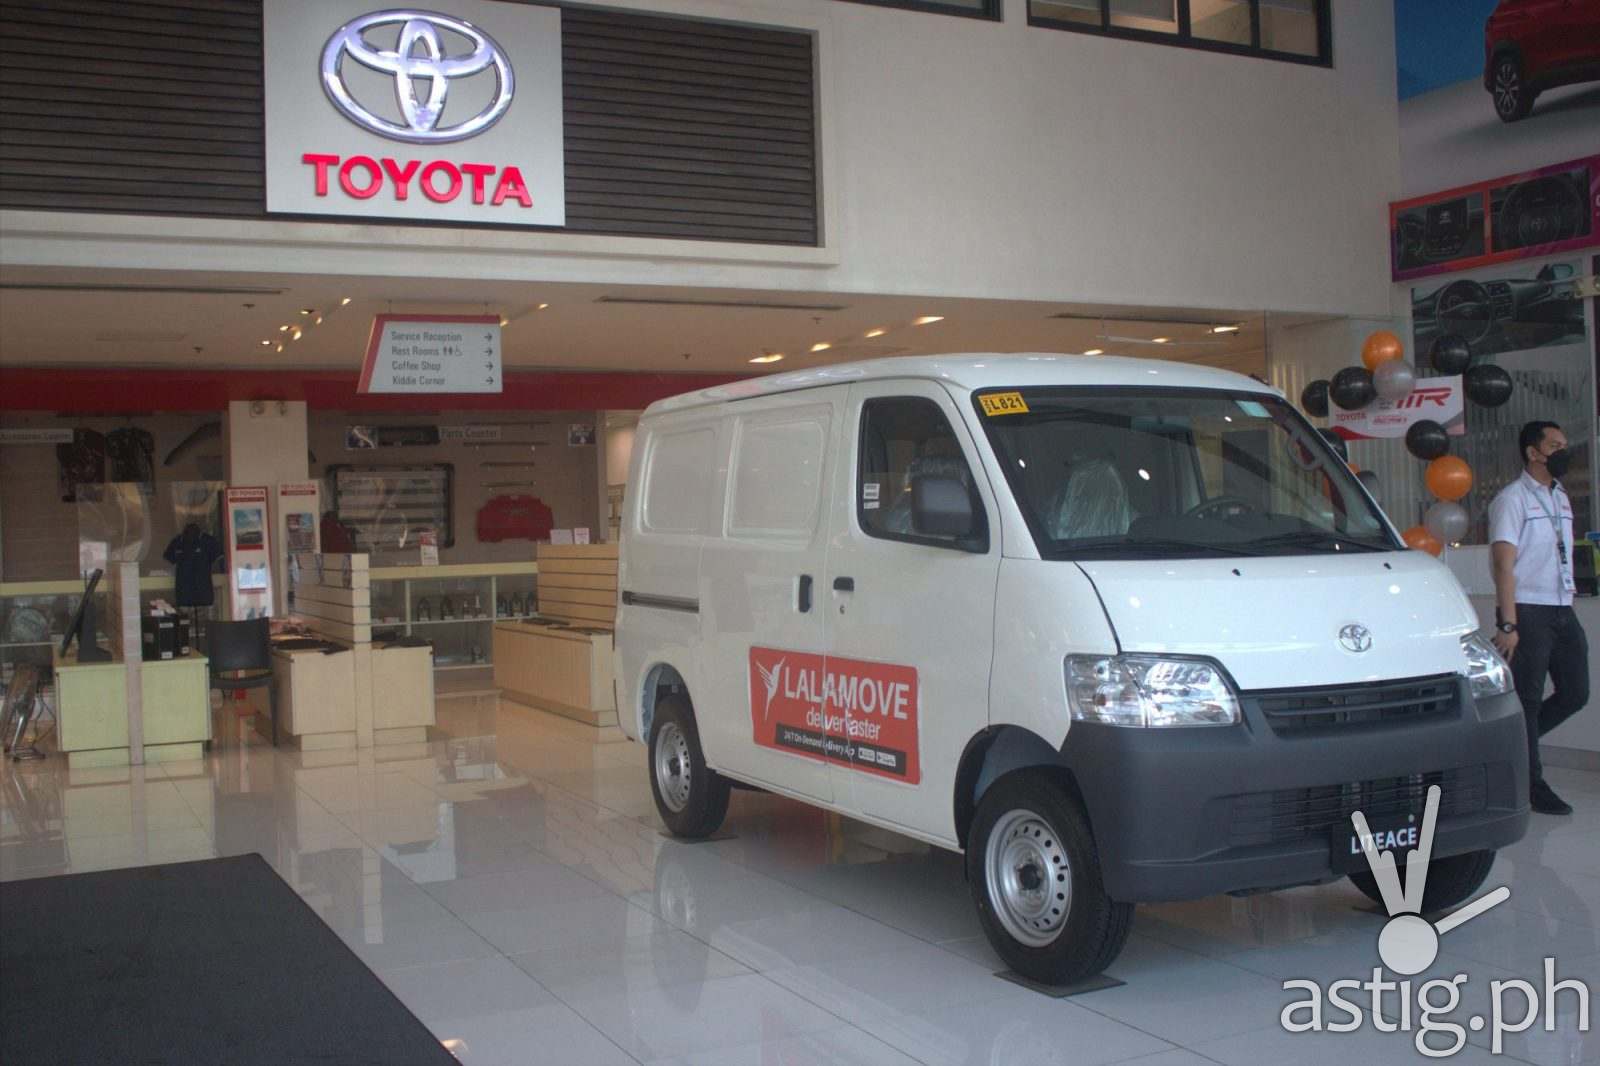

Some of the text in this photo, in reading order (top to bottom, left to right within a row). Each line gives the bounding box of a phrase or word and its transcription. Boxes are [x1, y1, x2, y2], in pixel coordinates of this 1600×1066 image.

[302, 153, 533, 208] TOYOTA
[391, 331, 463, 342] Service Reception
[391, 346, 439, 356] Rest Rooms
[391, 361, 441, 373] Coffee Shop
[392, 376, 446, 385] Kiddie Corner
[990, 397, 1024, 410] L821
[785, 666, 909, 720] LALAMOVE
[806, 706, 844, 731] delver
[1351, 827, 1417, 854] LITEACE
